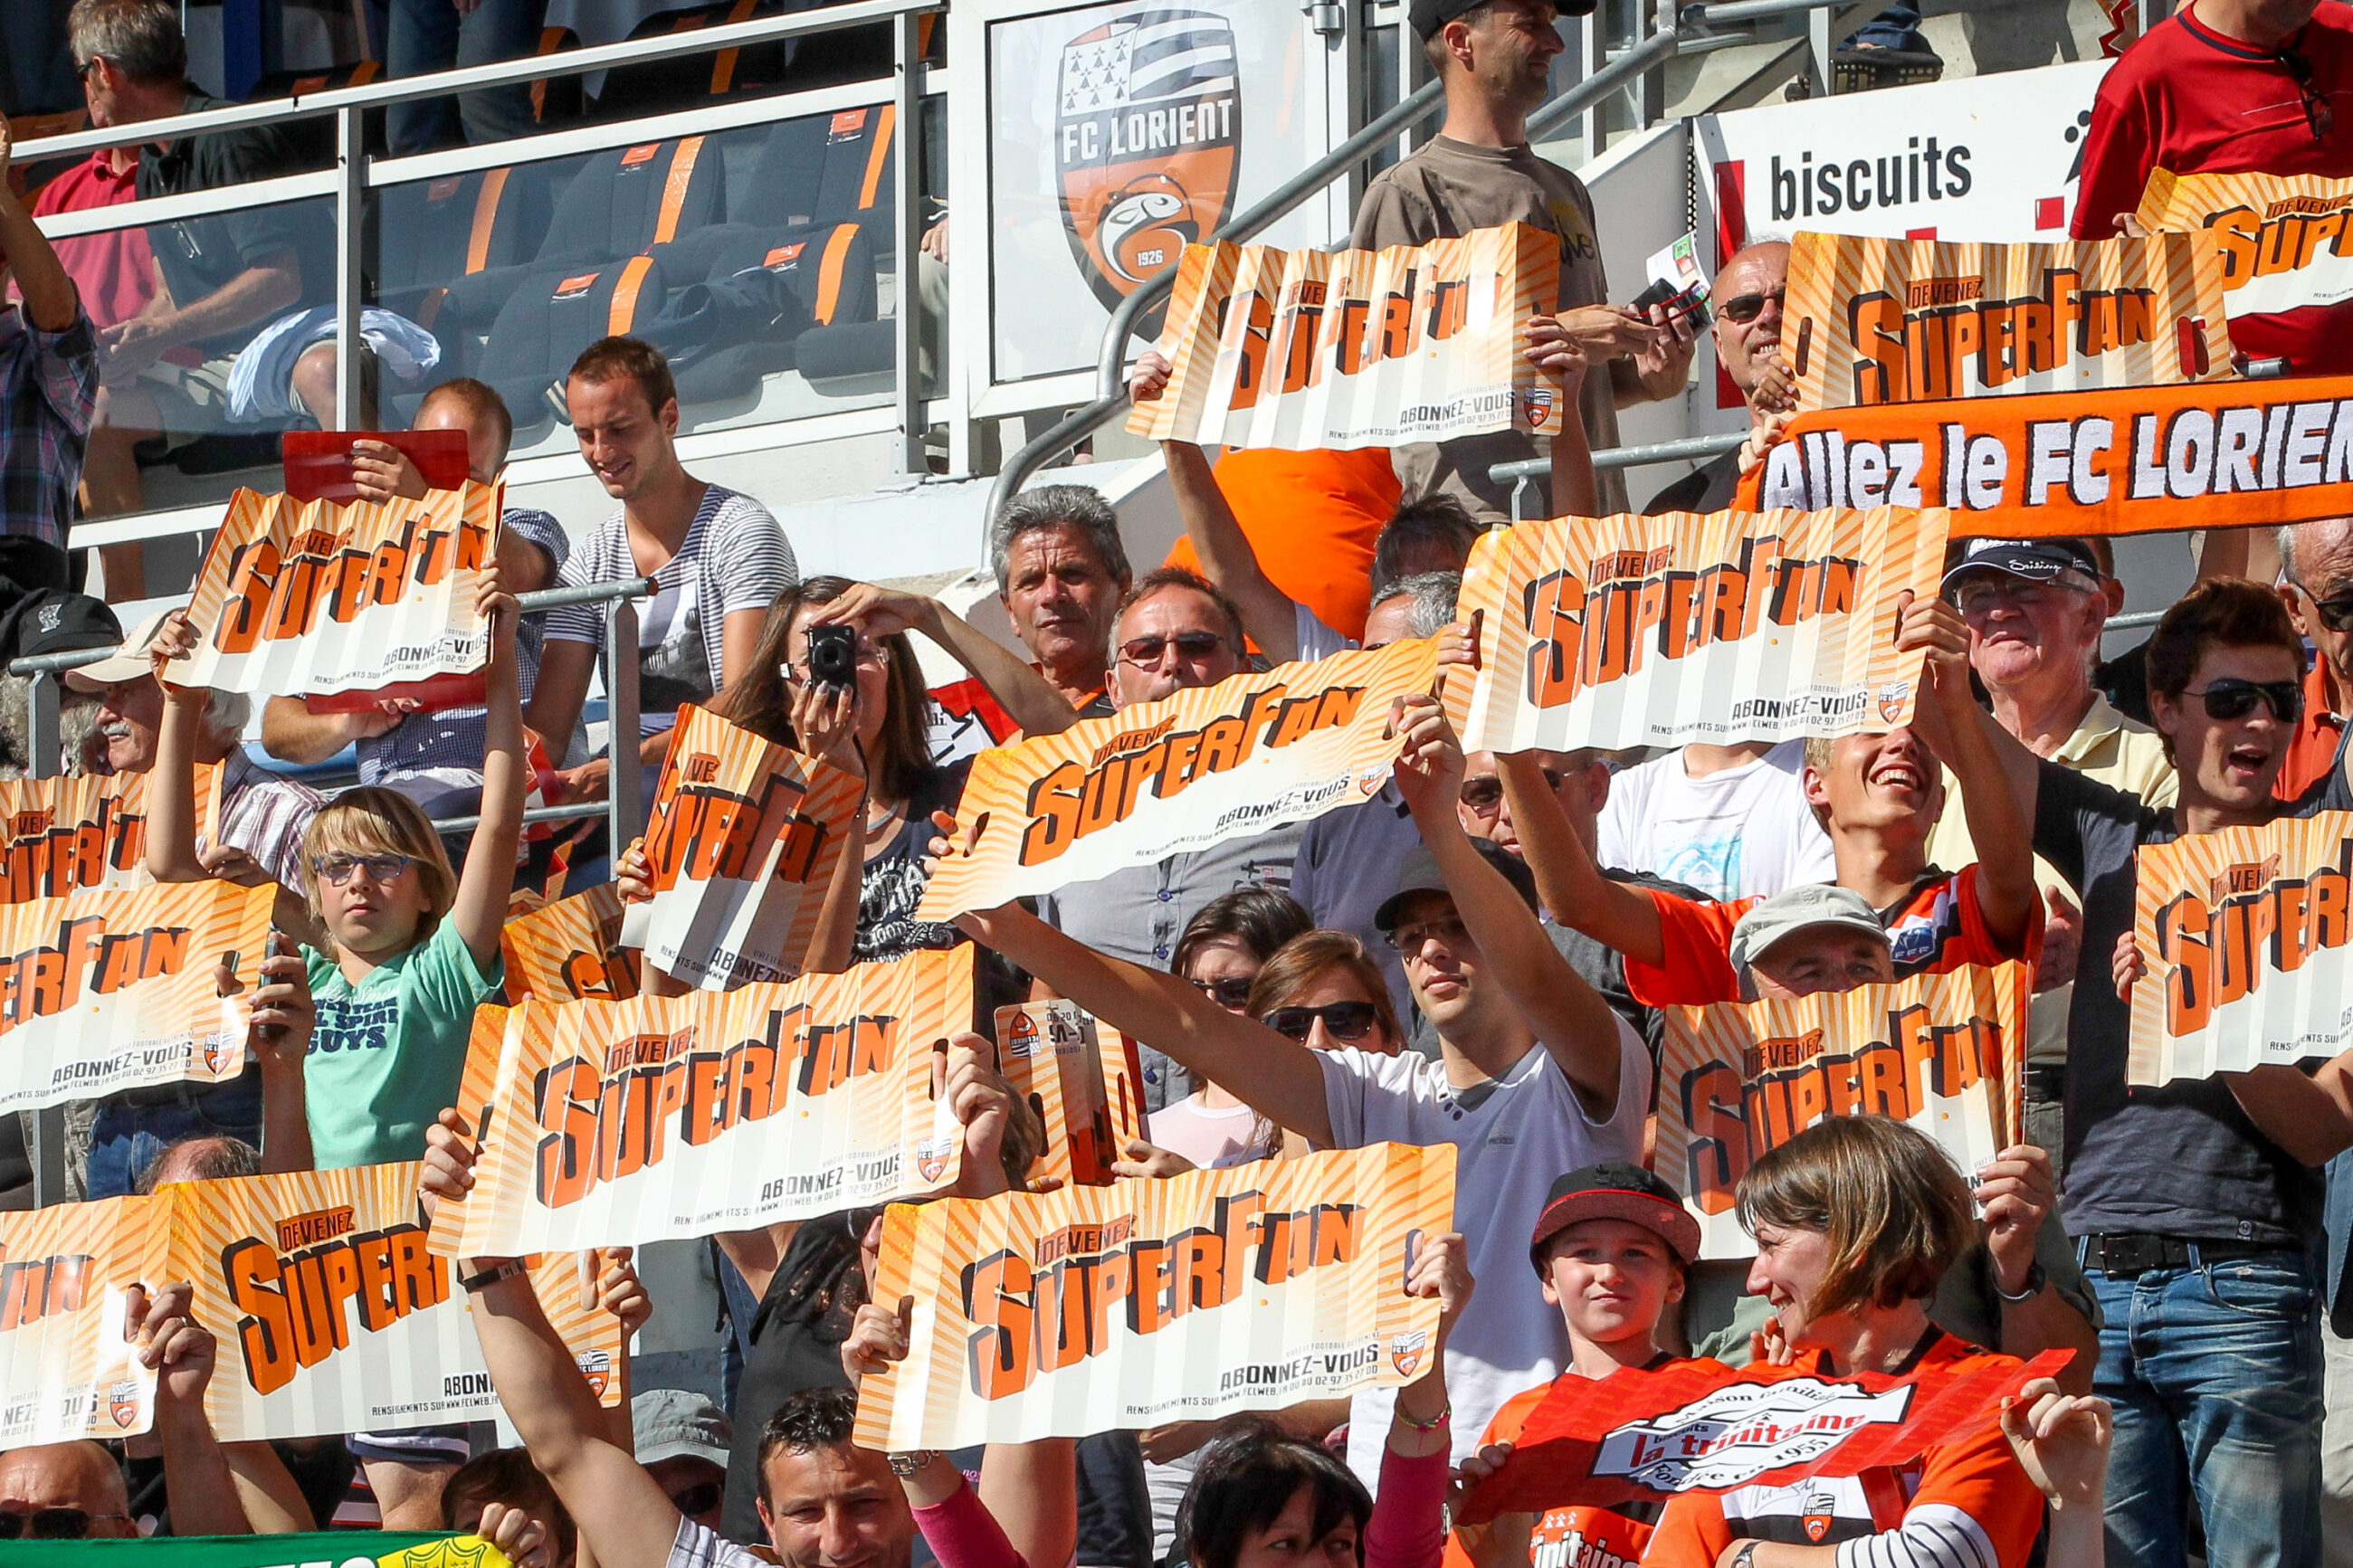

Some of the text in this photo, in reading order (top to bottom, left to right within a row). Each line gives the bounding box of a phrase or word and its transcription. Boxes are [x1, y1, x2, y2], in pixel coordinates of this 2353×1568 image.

[1062, 99, 1234, 164] FC LORIENT
[1770, 136, 1973, 222] biscuits
[1137, 249, 1164, 267] 1926
[2203, 204, 2353, 291] SUP
[1906, 274, 1984, 310] DEVENEZ
[1217, 262, 1505, 412] SUPERFA
[1849, 268, 2158, 404] SUPERFAN
[1399, 391, 1516, 425] ABONNEZ-VOUS
[1759, 428, 1924, 513] Allez
[1939, 422, 2007, 509] le
[2024, 415, 2114, 506] FC
[1524, 535, 1867, 709] SUPERFAN
[1732, 691, 1869, 720] ABONNEZ-VOUS
[1811, 716, 1822, 725] 02
[1824, 717, 1834, 726] 97
[1019, 683, 1367, 867] SUPERFAN
[1215, 775, 1350, 830] ABONNEZ-VOUS
[1895, 946, 1929, 959] FFF
[2156, 838, 2353, 1038] SUPER
[52, 1041, 194, 1085] ABONNEZ-VOUS
[134, 1068, 144, 1077] 02
[147, 1067, 157, 1075] 97
[606, 1025, 696, 1074] DEVENEZ
[535, 1002, 900, 1209] SUPERFAN
[761, 1153, 904, 1202] ABONNEZ-VOUS
[274, 1205, 356, 1252] DEVENEZ
[1035, 1213, 1137, 1268] DEVENEZ
[221, 1222, 451, 1396] SUPER
[961, 1189, 1366, 1401] SUPERFAN
[1220, 1343, 1379, 1392] ABONNEZ-VOUS
[1310, 1341, 1344, 1351] FOOTBALL
[1315, 1375, 1328, 1386] 02
[1330, 1374, 1342, 1386] 97
[1365, 1364, 1378, 1375] 00
[1631, 1412, 1866, 1468] la trinitaine
[1775, 1439, 1830, 1461] 1955
